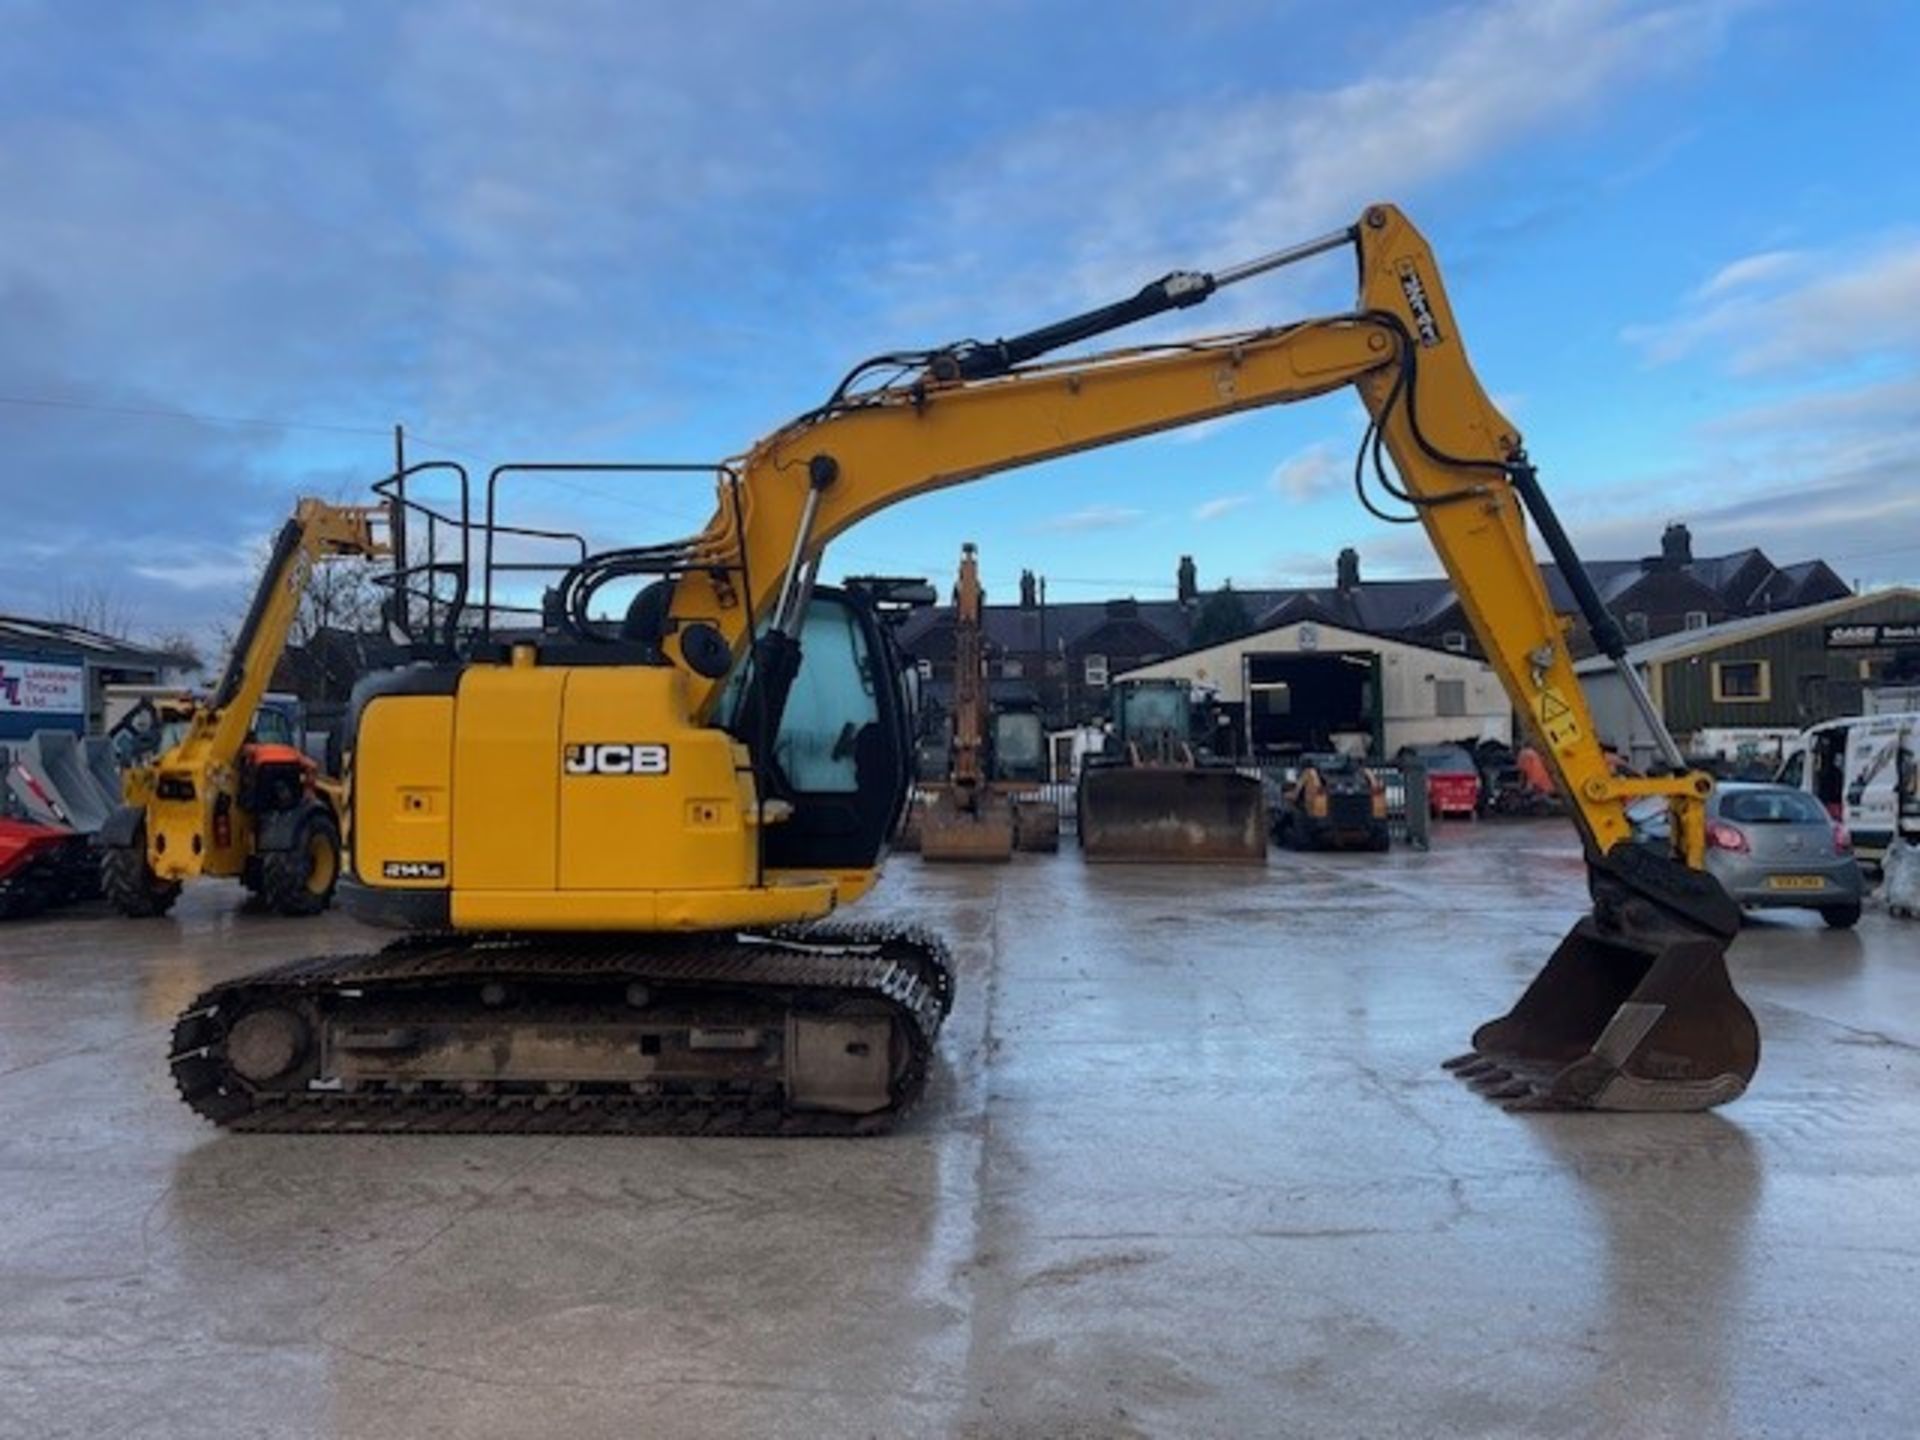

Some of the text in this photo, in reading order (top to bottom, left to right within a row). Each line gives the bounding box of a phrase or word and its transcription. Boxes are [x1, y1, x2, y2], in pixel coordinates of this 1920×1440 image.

[24, 667, 82, 681] Lakeland
[25, 681, 68, 695] Trucks
[566, 745, 667, 773] JCB
